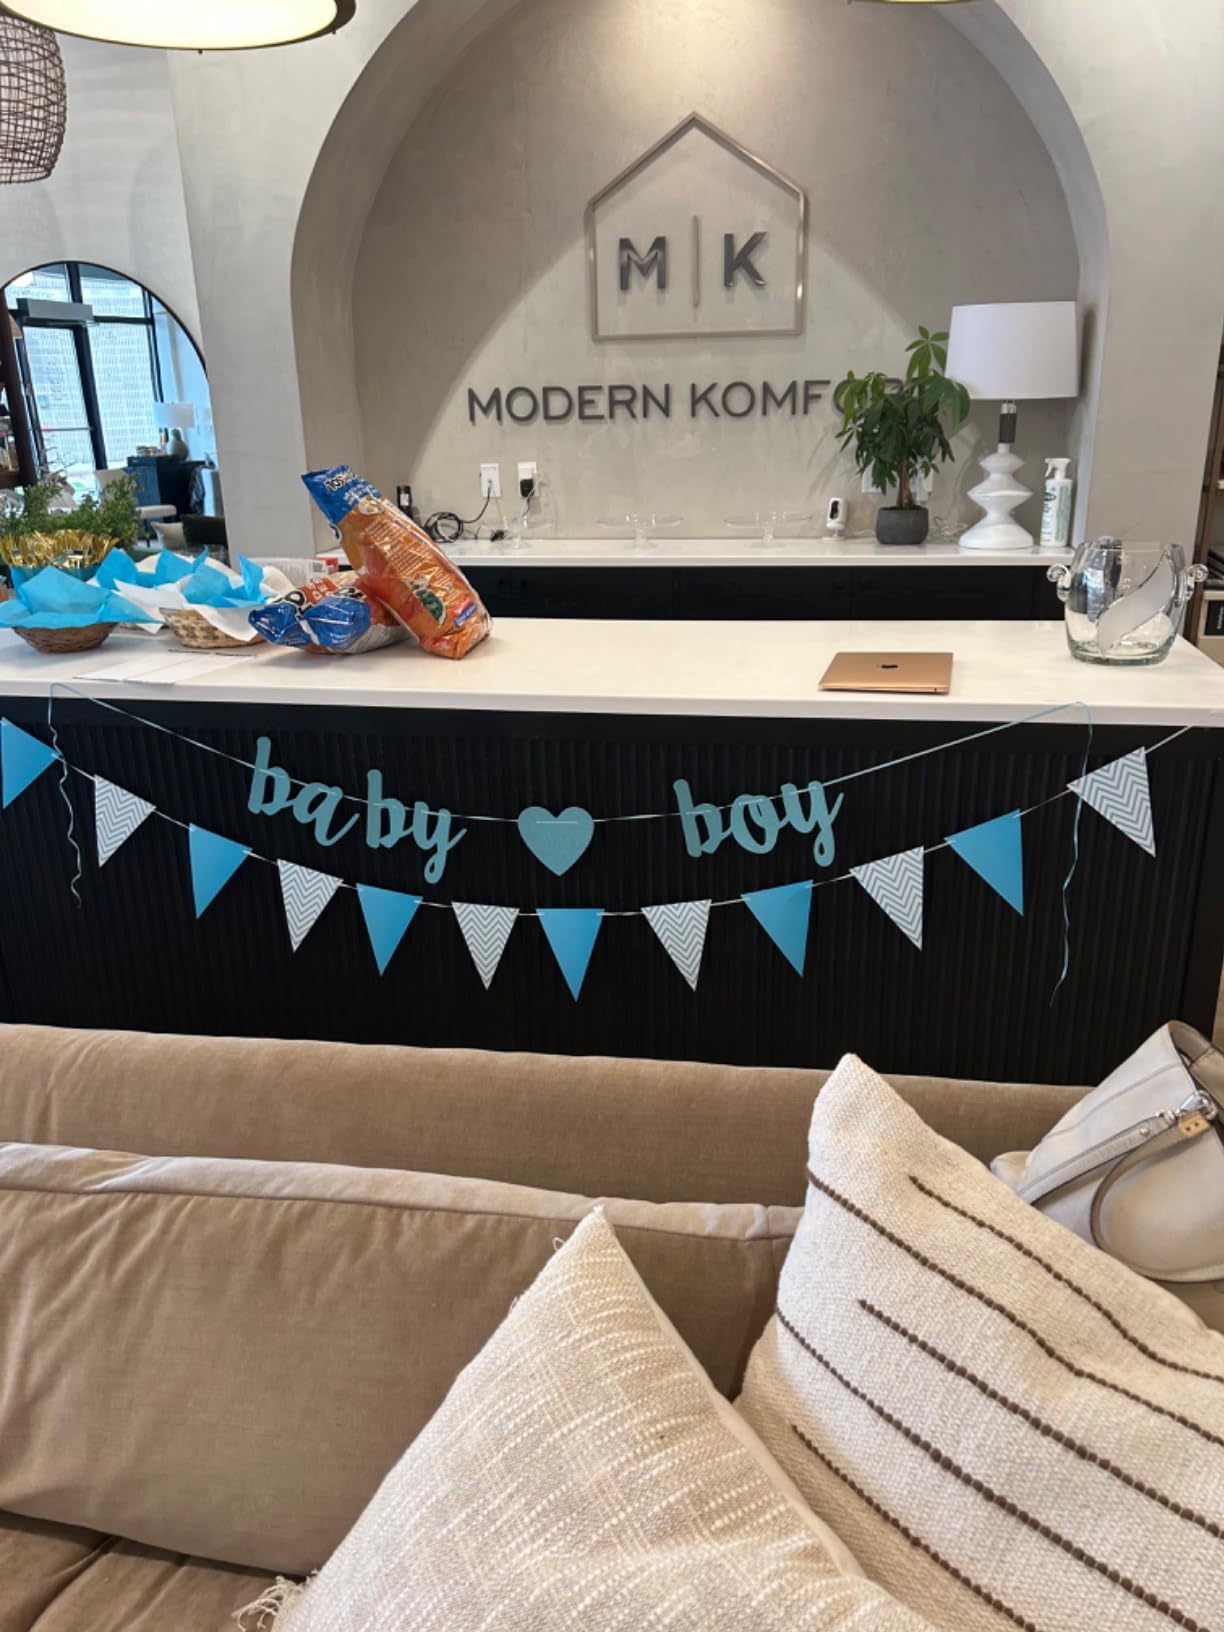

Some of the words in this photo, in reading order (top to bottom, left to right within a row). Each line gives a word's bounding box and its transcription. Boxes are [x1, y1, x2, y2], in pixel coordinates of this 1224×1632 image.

[619, 236, 667, 291] M
[723, 231, 767, 288] K
[467, 383, 671, 424] MODERN
[247, 736, 467, 884] baby
[673, 778, 844, 867] boy
